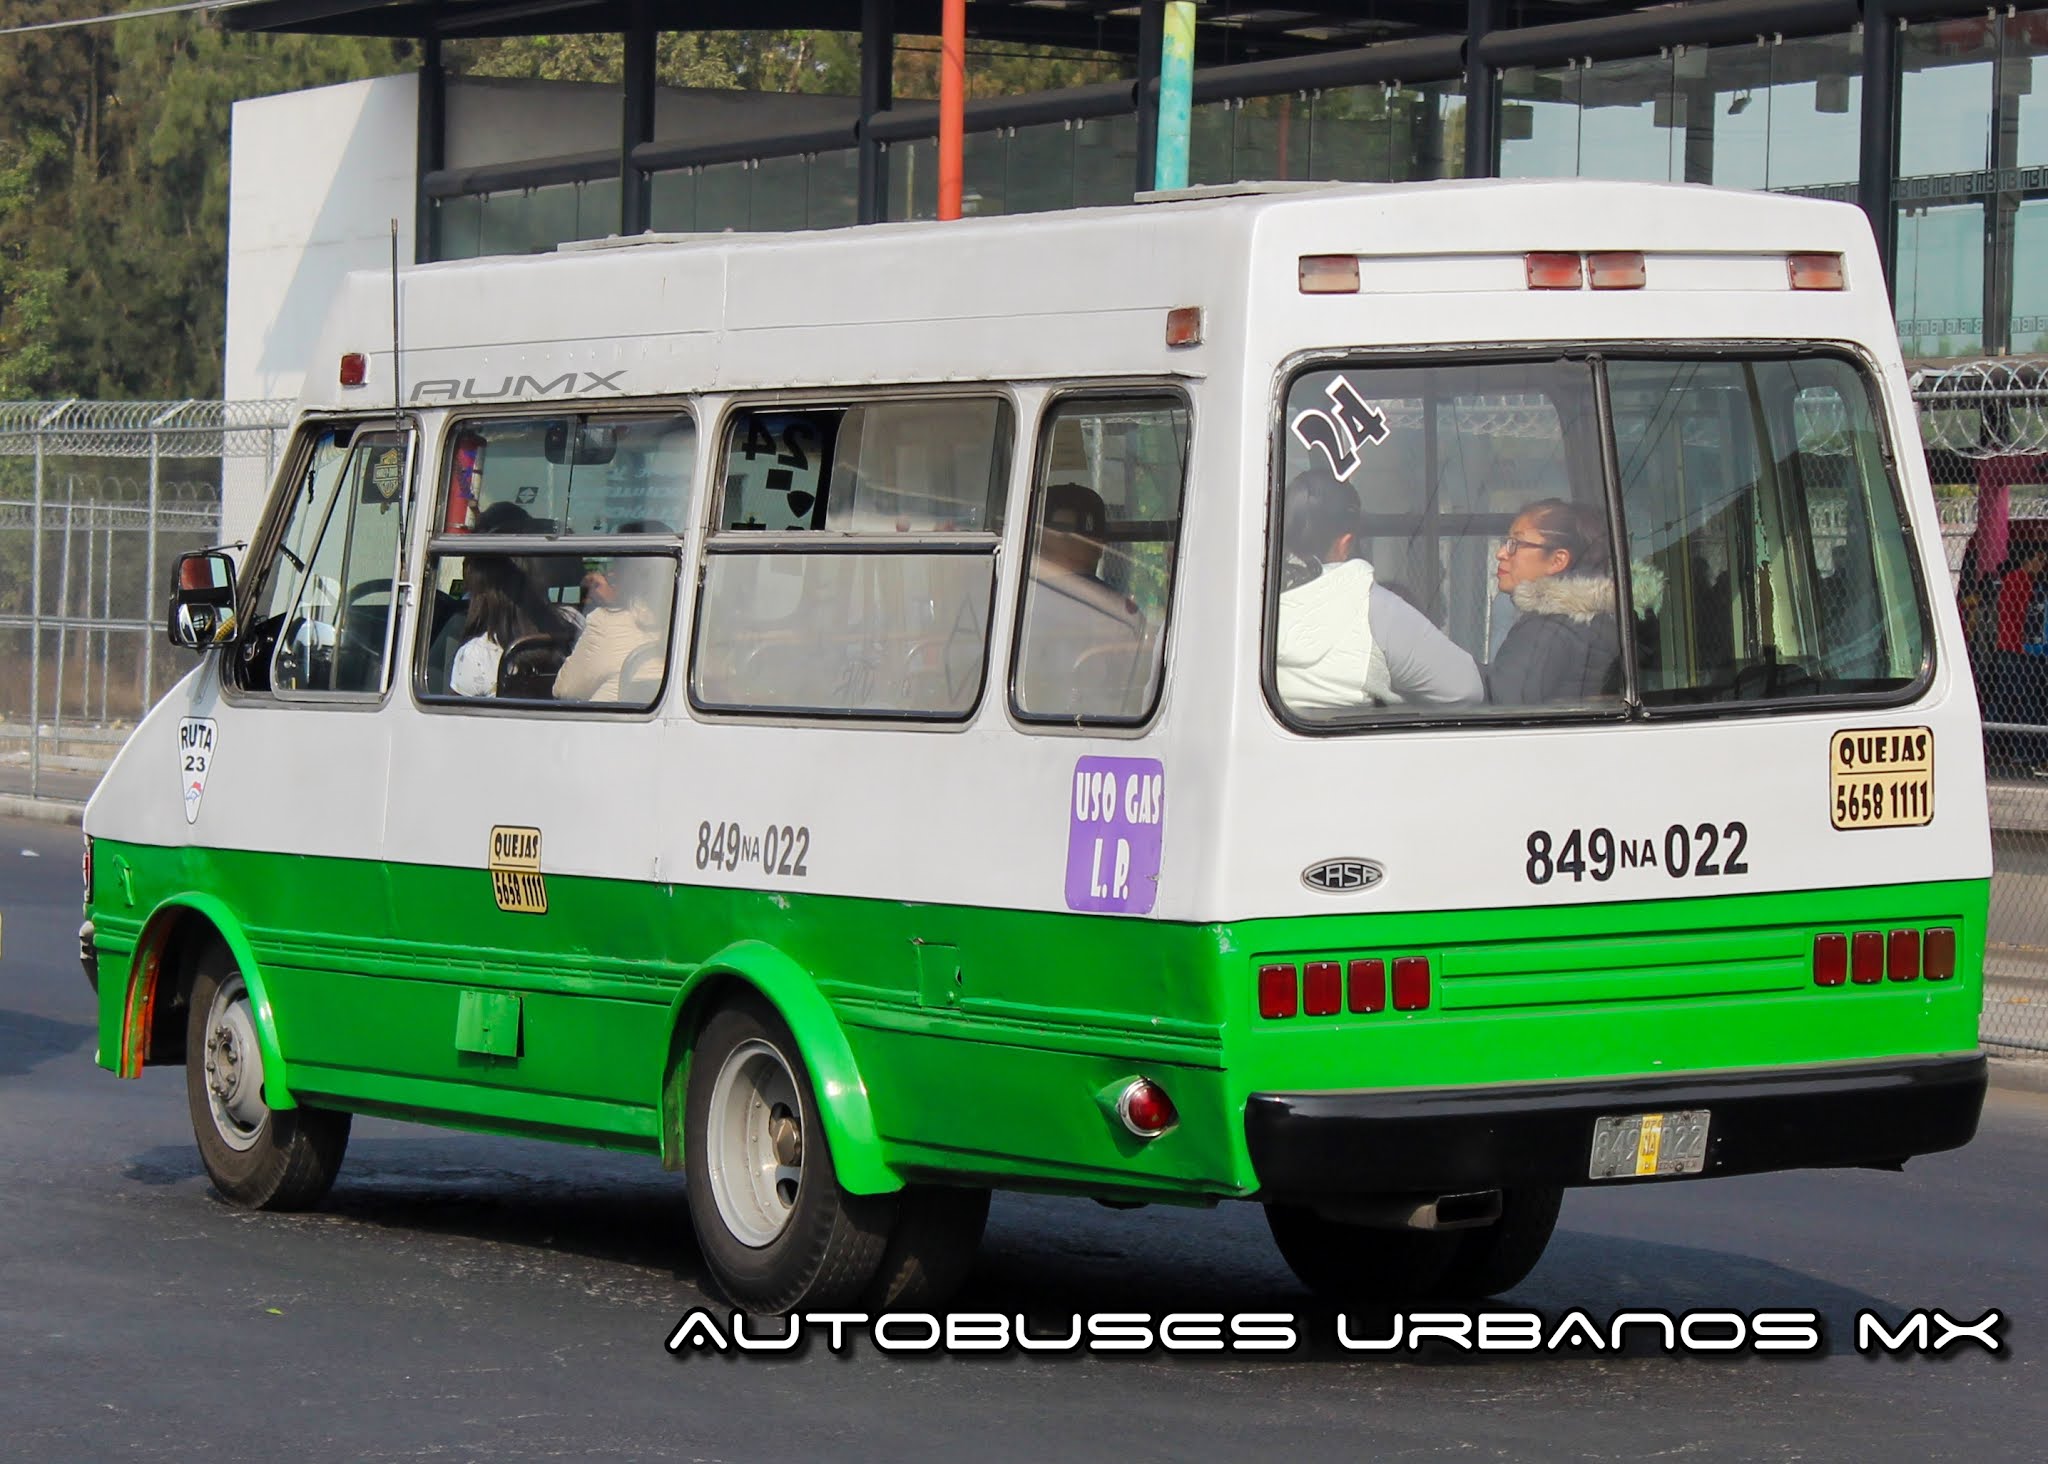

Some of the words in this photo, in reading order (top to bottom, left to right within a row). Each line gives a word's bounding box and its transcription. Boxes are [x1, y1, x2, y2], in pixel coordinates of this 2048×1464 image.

[1291, 374, 1391, 482] 24
[181, 723, 212, 752] RUTA
[1840, 734, 1927, 769] QUEJAS
[184, 755, 206, 773] 23
[1076, 771, 1117, 823] USO
[1125, 774, 1162, 825] GAS
[1837, 782, 1884, 822] 5658
[1890, 780, 1928, 818] 1111
[494, 832, 539, 860] QUEJAS
[495, 871, 522, 905] 5658
[521, 874, 545, 908] 1111
